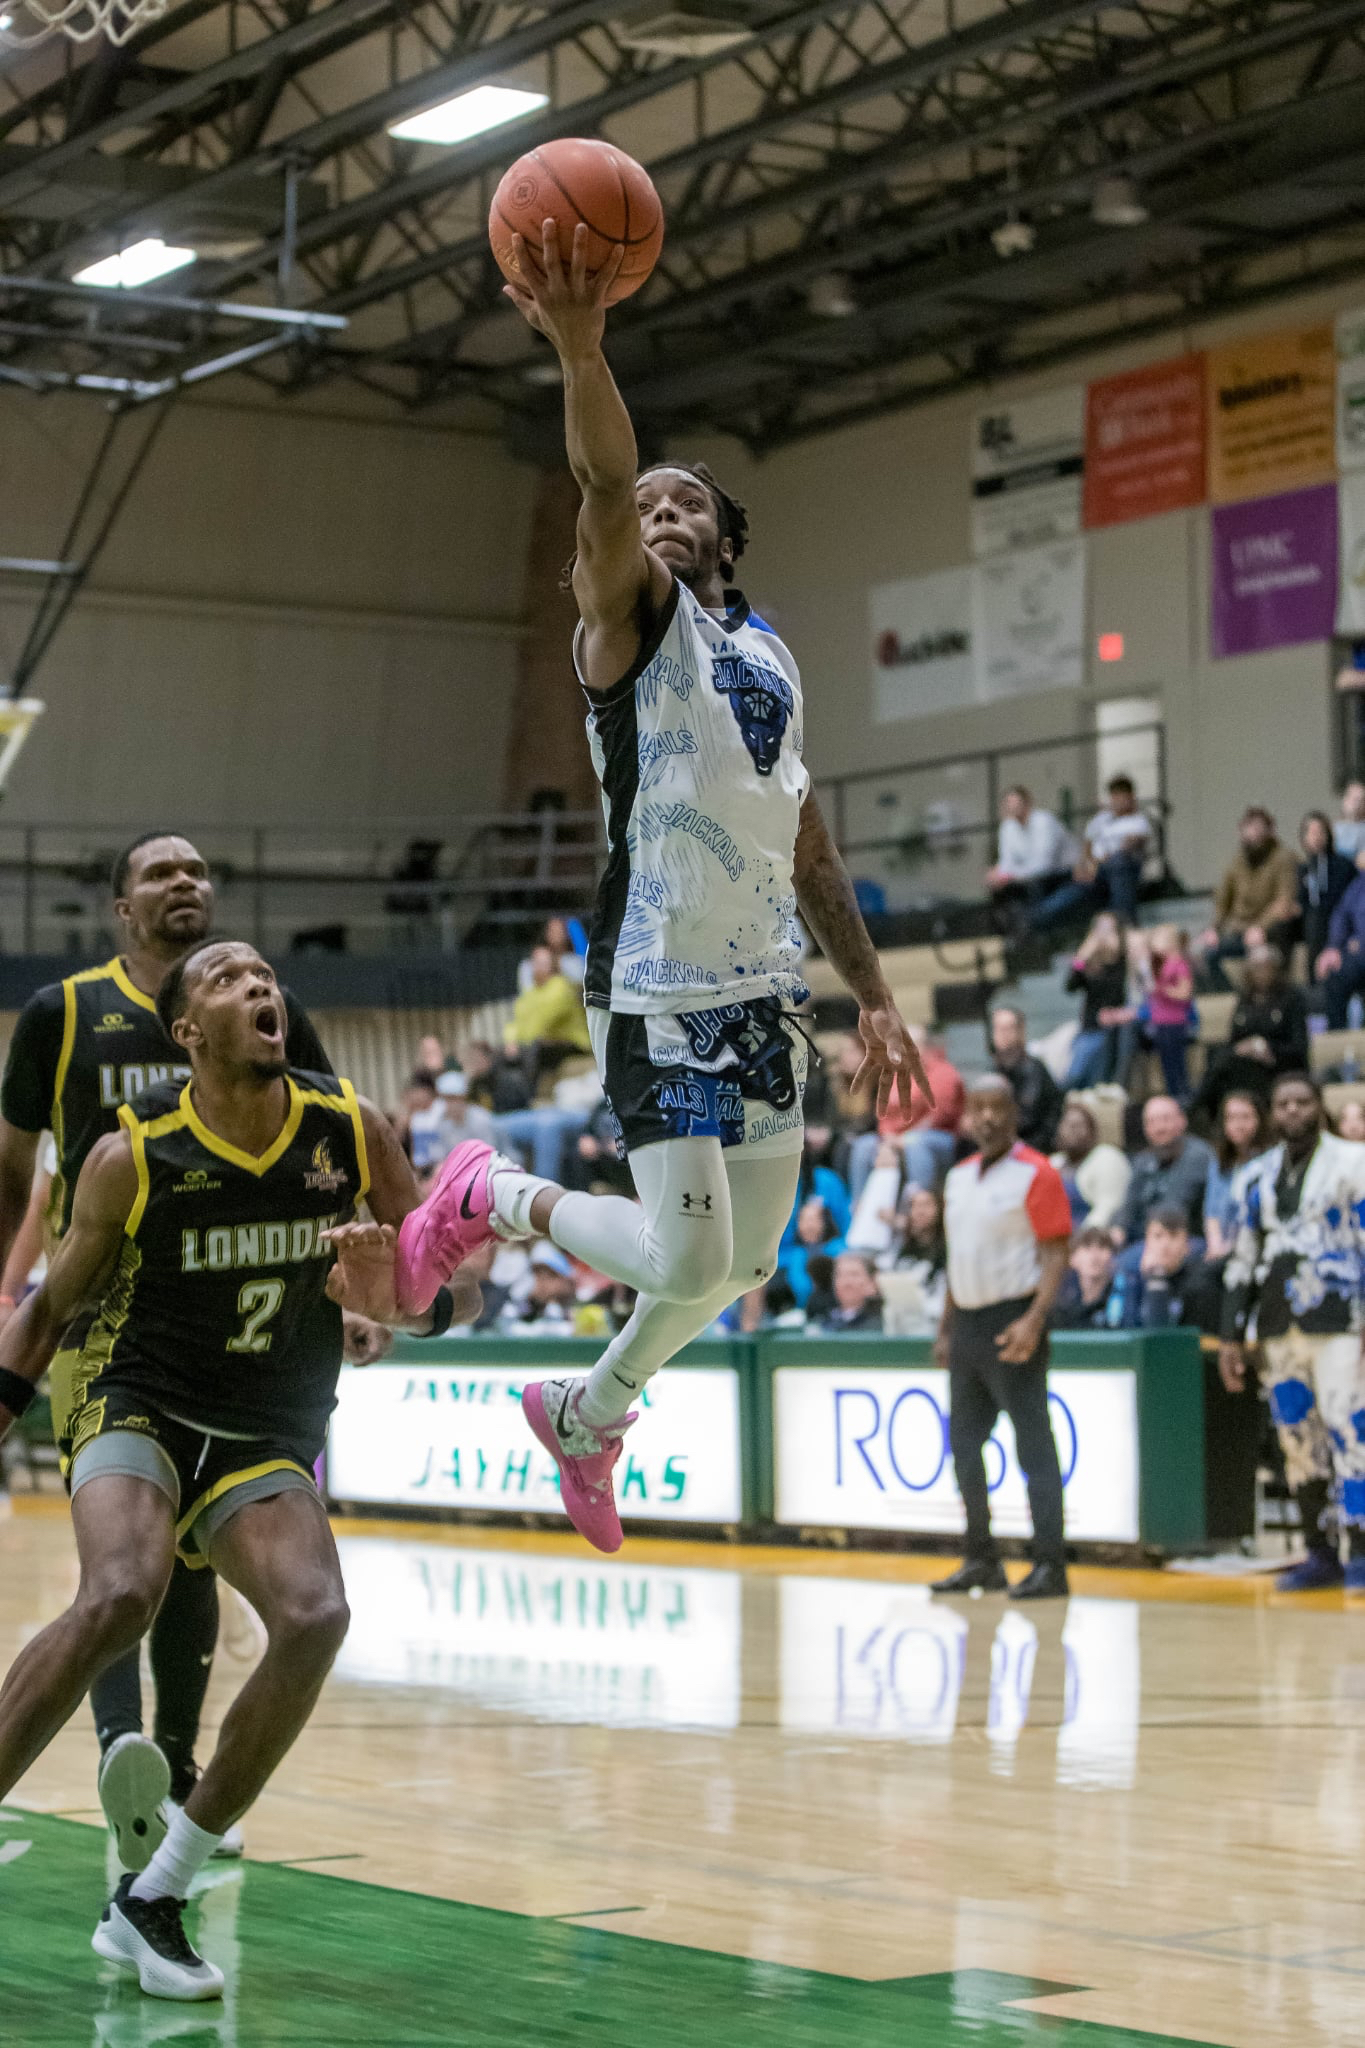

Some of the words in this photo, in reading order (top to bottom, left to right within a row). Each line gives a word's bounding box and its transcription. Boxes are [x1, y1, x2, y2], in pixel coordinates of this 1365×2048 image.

[660, 803, 745, 882] JACKALS
[181, 1212, 338, 1272] LONDON
[225, 1276, 286, 1353] 2
[409, 1446, 690, 1503] JAYHAKS
